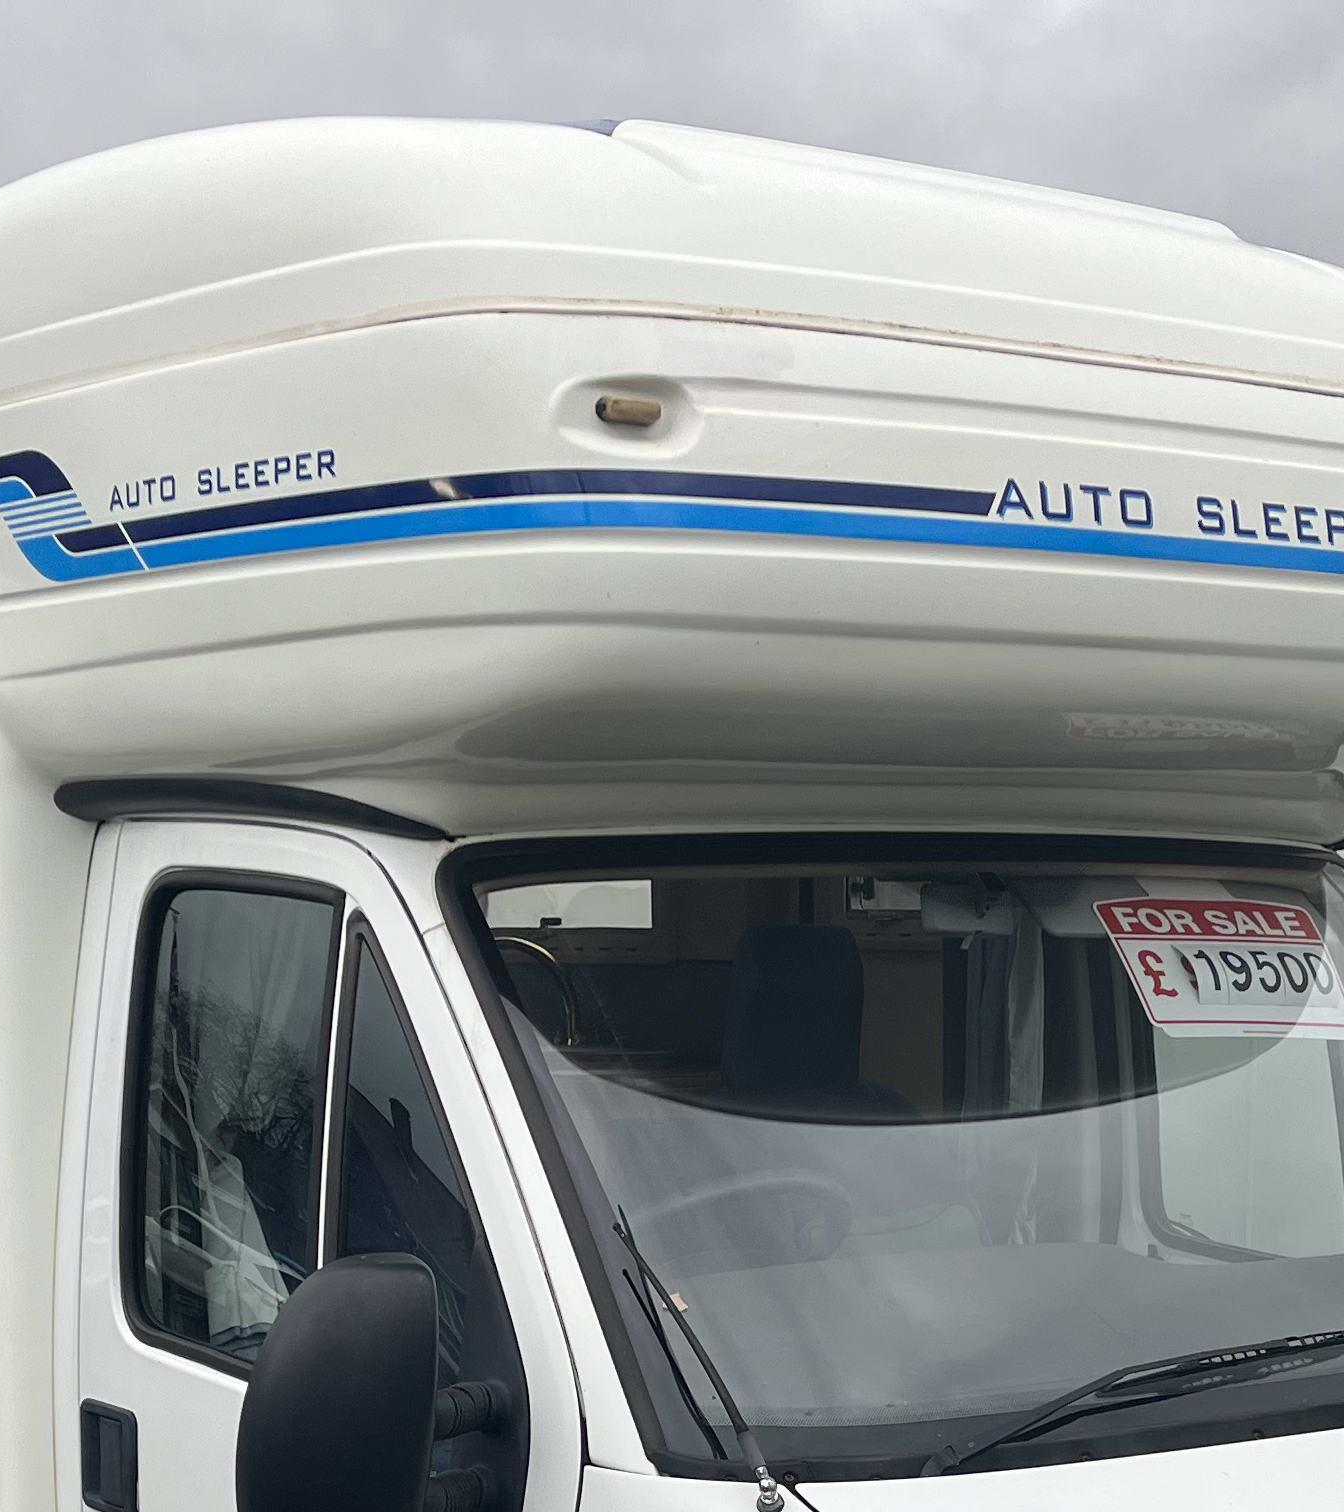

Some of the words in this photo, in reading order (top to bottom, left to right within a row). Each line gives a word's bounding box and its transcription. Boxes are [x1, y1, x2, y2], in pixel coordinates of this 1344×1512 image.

[109, 475, 176, 512] AUTO
[197, 449, 336, 496] SLEEPER
[996, 477, 1154, 529] AUTO
[1111, 906, 1202, 935] FOR
[1204, 909, 1306, 937] SALE
